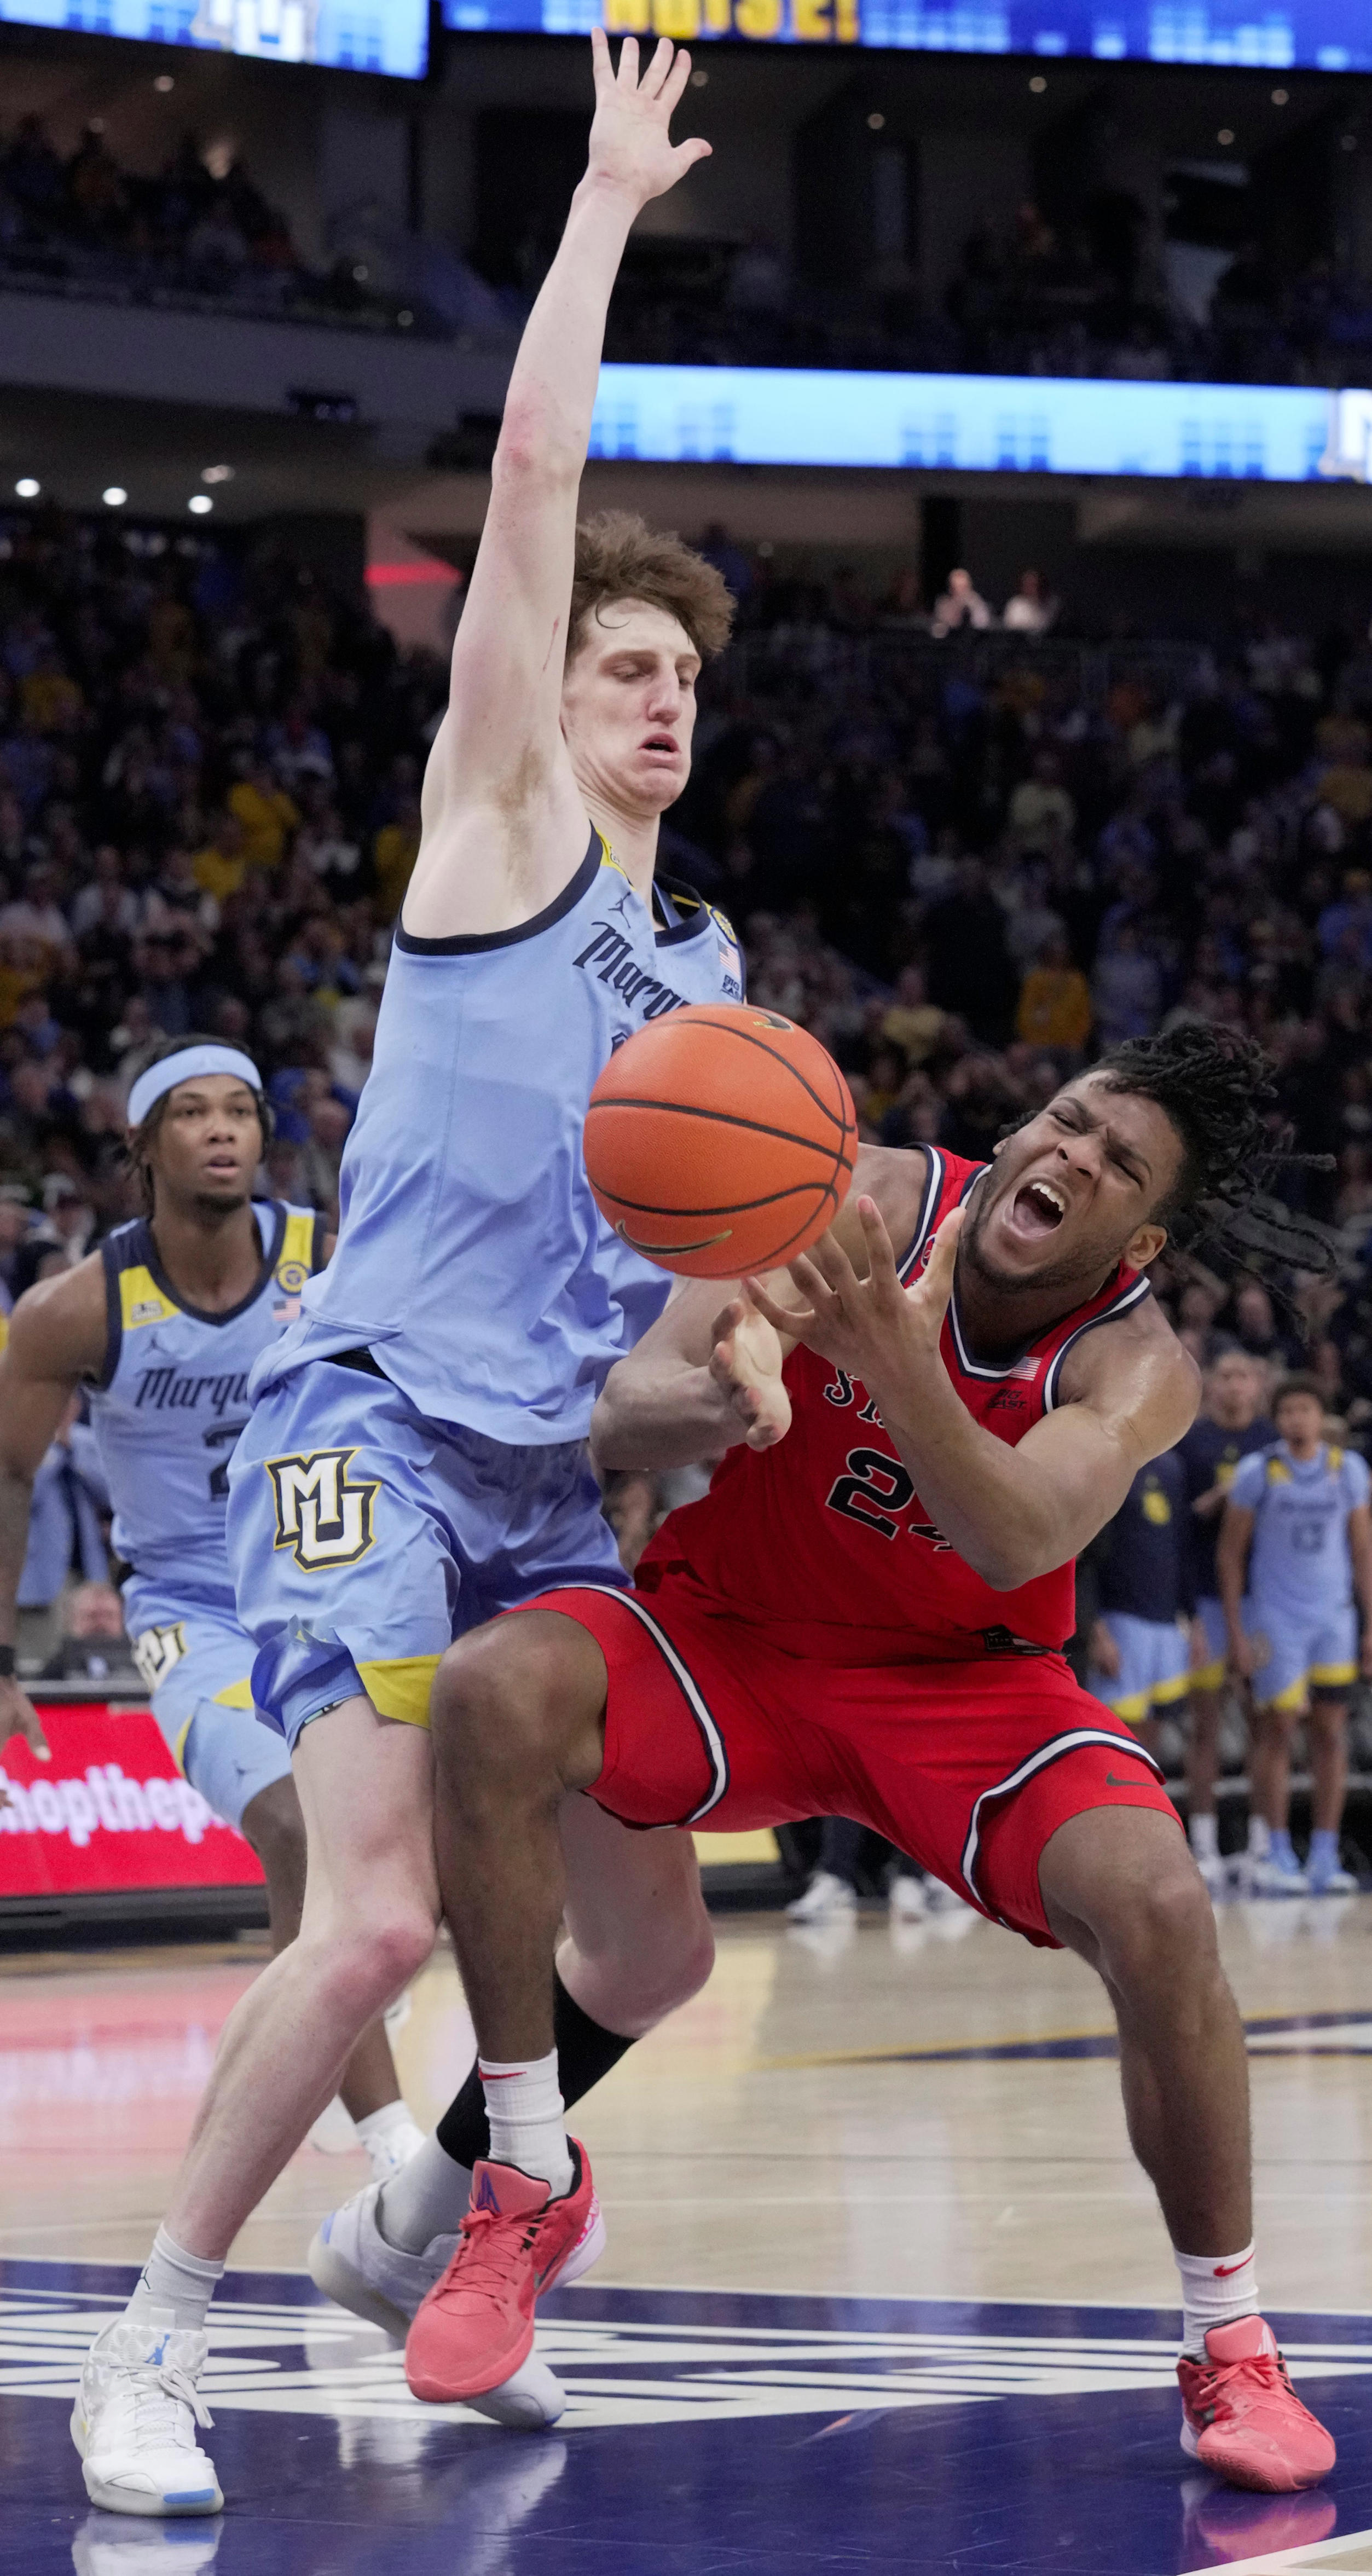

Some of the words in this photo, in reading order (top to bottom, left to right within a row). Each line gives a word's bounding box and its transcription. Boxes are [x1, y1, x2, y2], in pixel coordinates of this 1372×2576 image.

[572, 921, 691, 1020] Marq
[987, 1399, 1027, 1411] EAST
[994, 1388, 1022, 1399] BIG
[267, 1450, 376, 1570] MU
